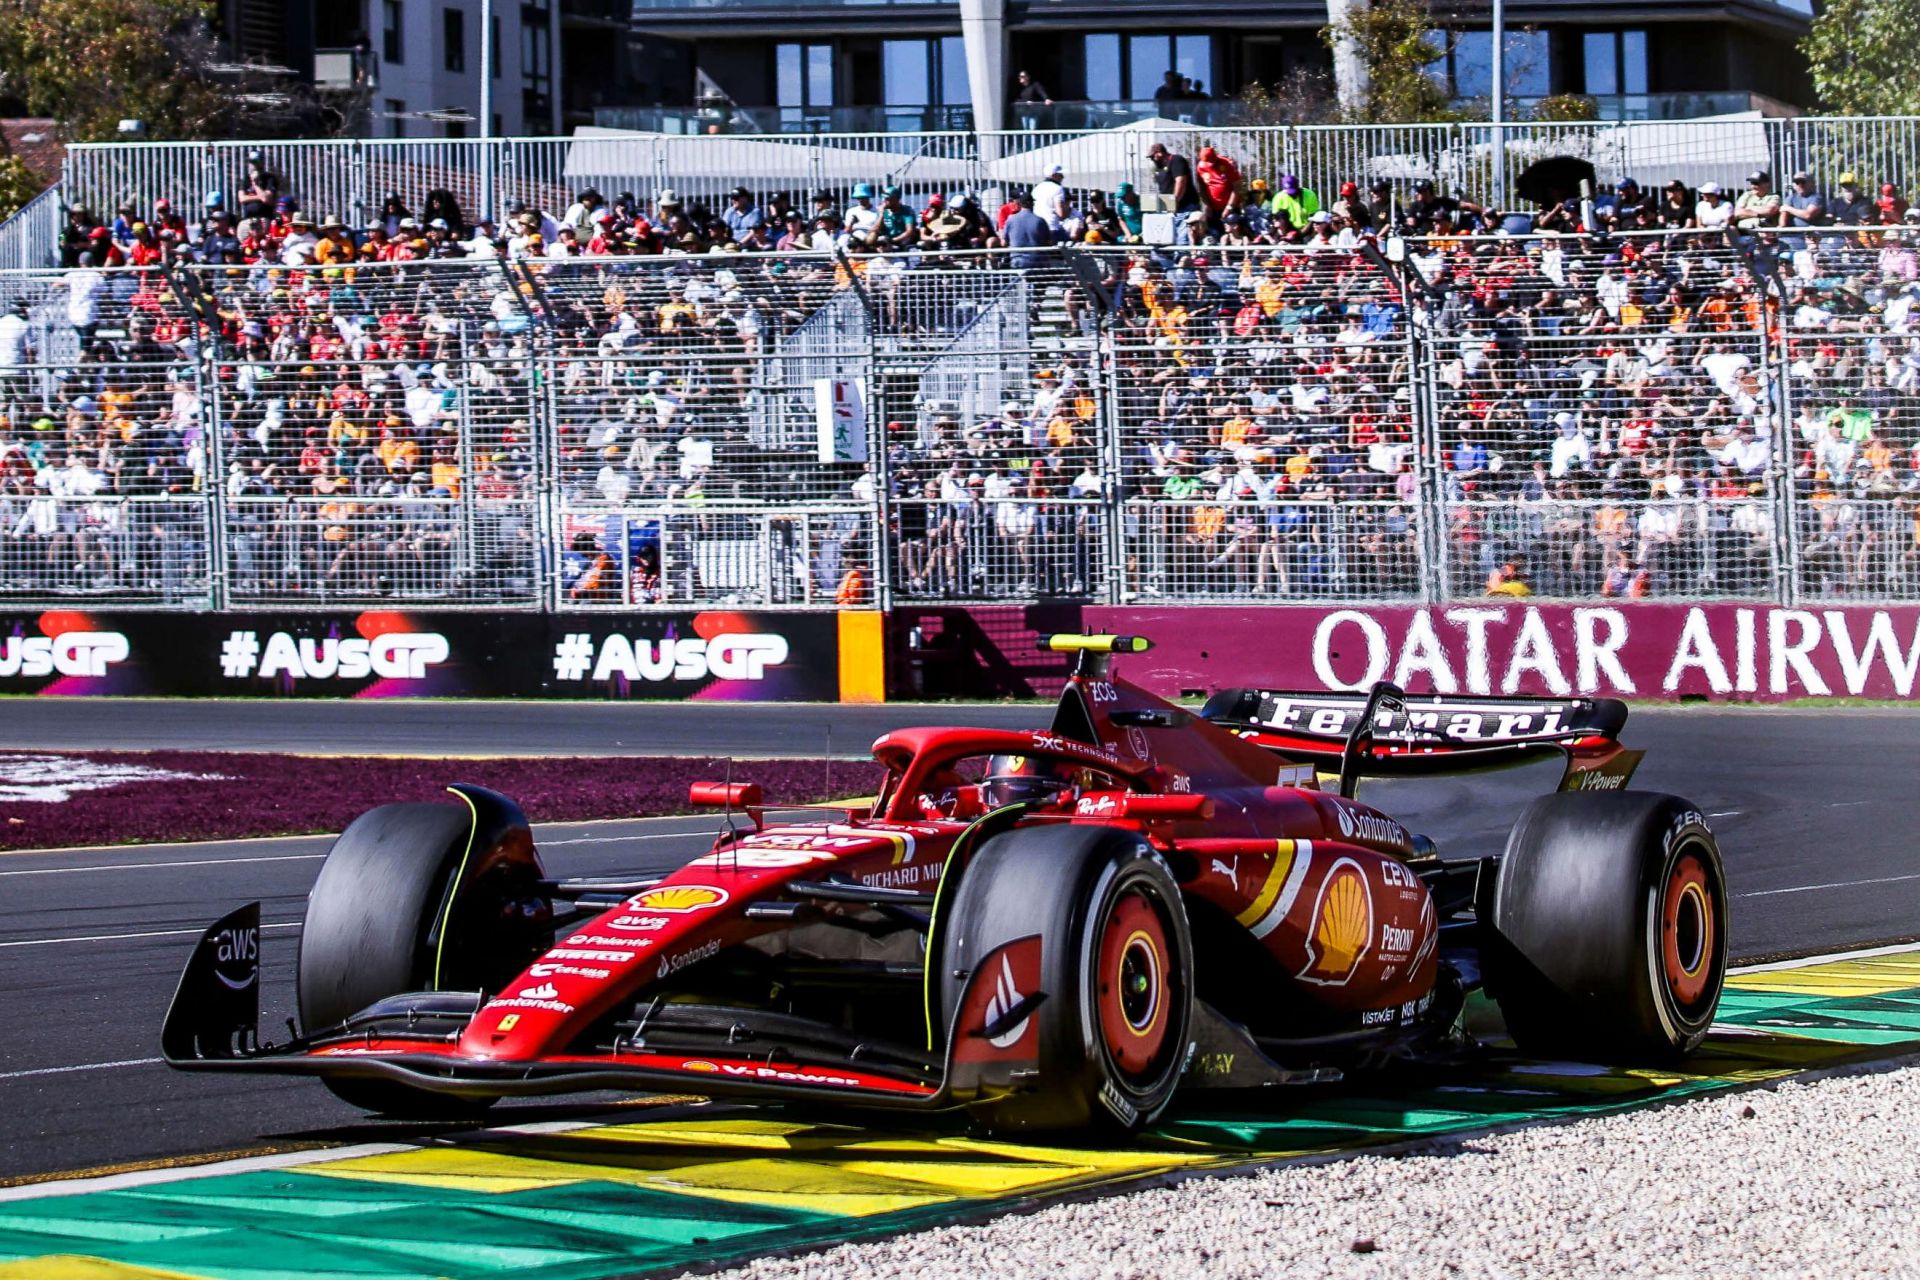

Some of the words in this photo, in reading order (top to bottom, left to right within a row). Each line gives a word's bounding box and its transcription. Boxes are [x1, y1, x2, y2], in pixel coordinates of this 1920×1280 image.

[1312, 607, 1636, 695] QATAR
[1089, 682, 1118, 702] ZCG
[1262, 698, 1564, 739] Ferrari
[1032, 735, 1064, 751] DXC
[1067, 742, 1118, 764] TECHNOLOGY
[1173, 774, 1191, 793] aws
[1581, 771, 1625, 791] V-Power
[1349, 807, 1404, 847] Santander
[863, 866, 919, 888] RICHARD
[613, 916, 670, 925] aws
[218, 929, 258, 962] aws
[587, 936, 653, 947] Palantir
[670, 938, 722, 974] Santander
[722, 1064, 860, 1085] V-Power
